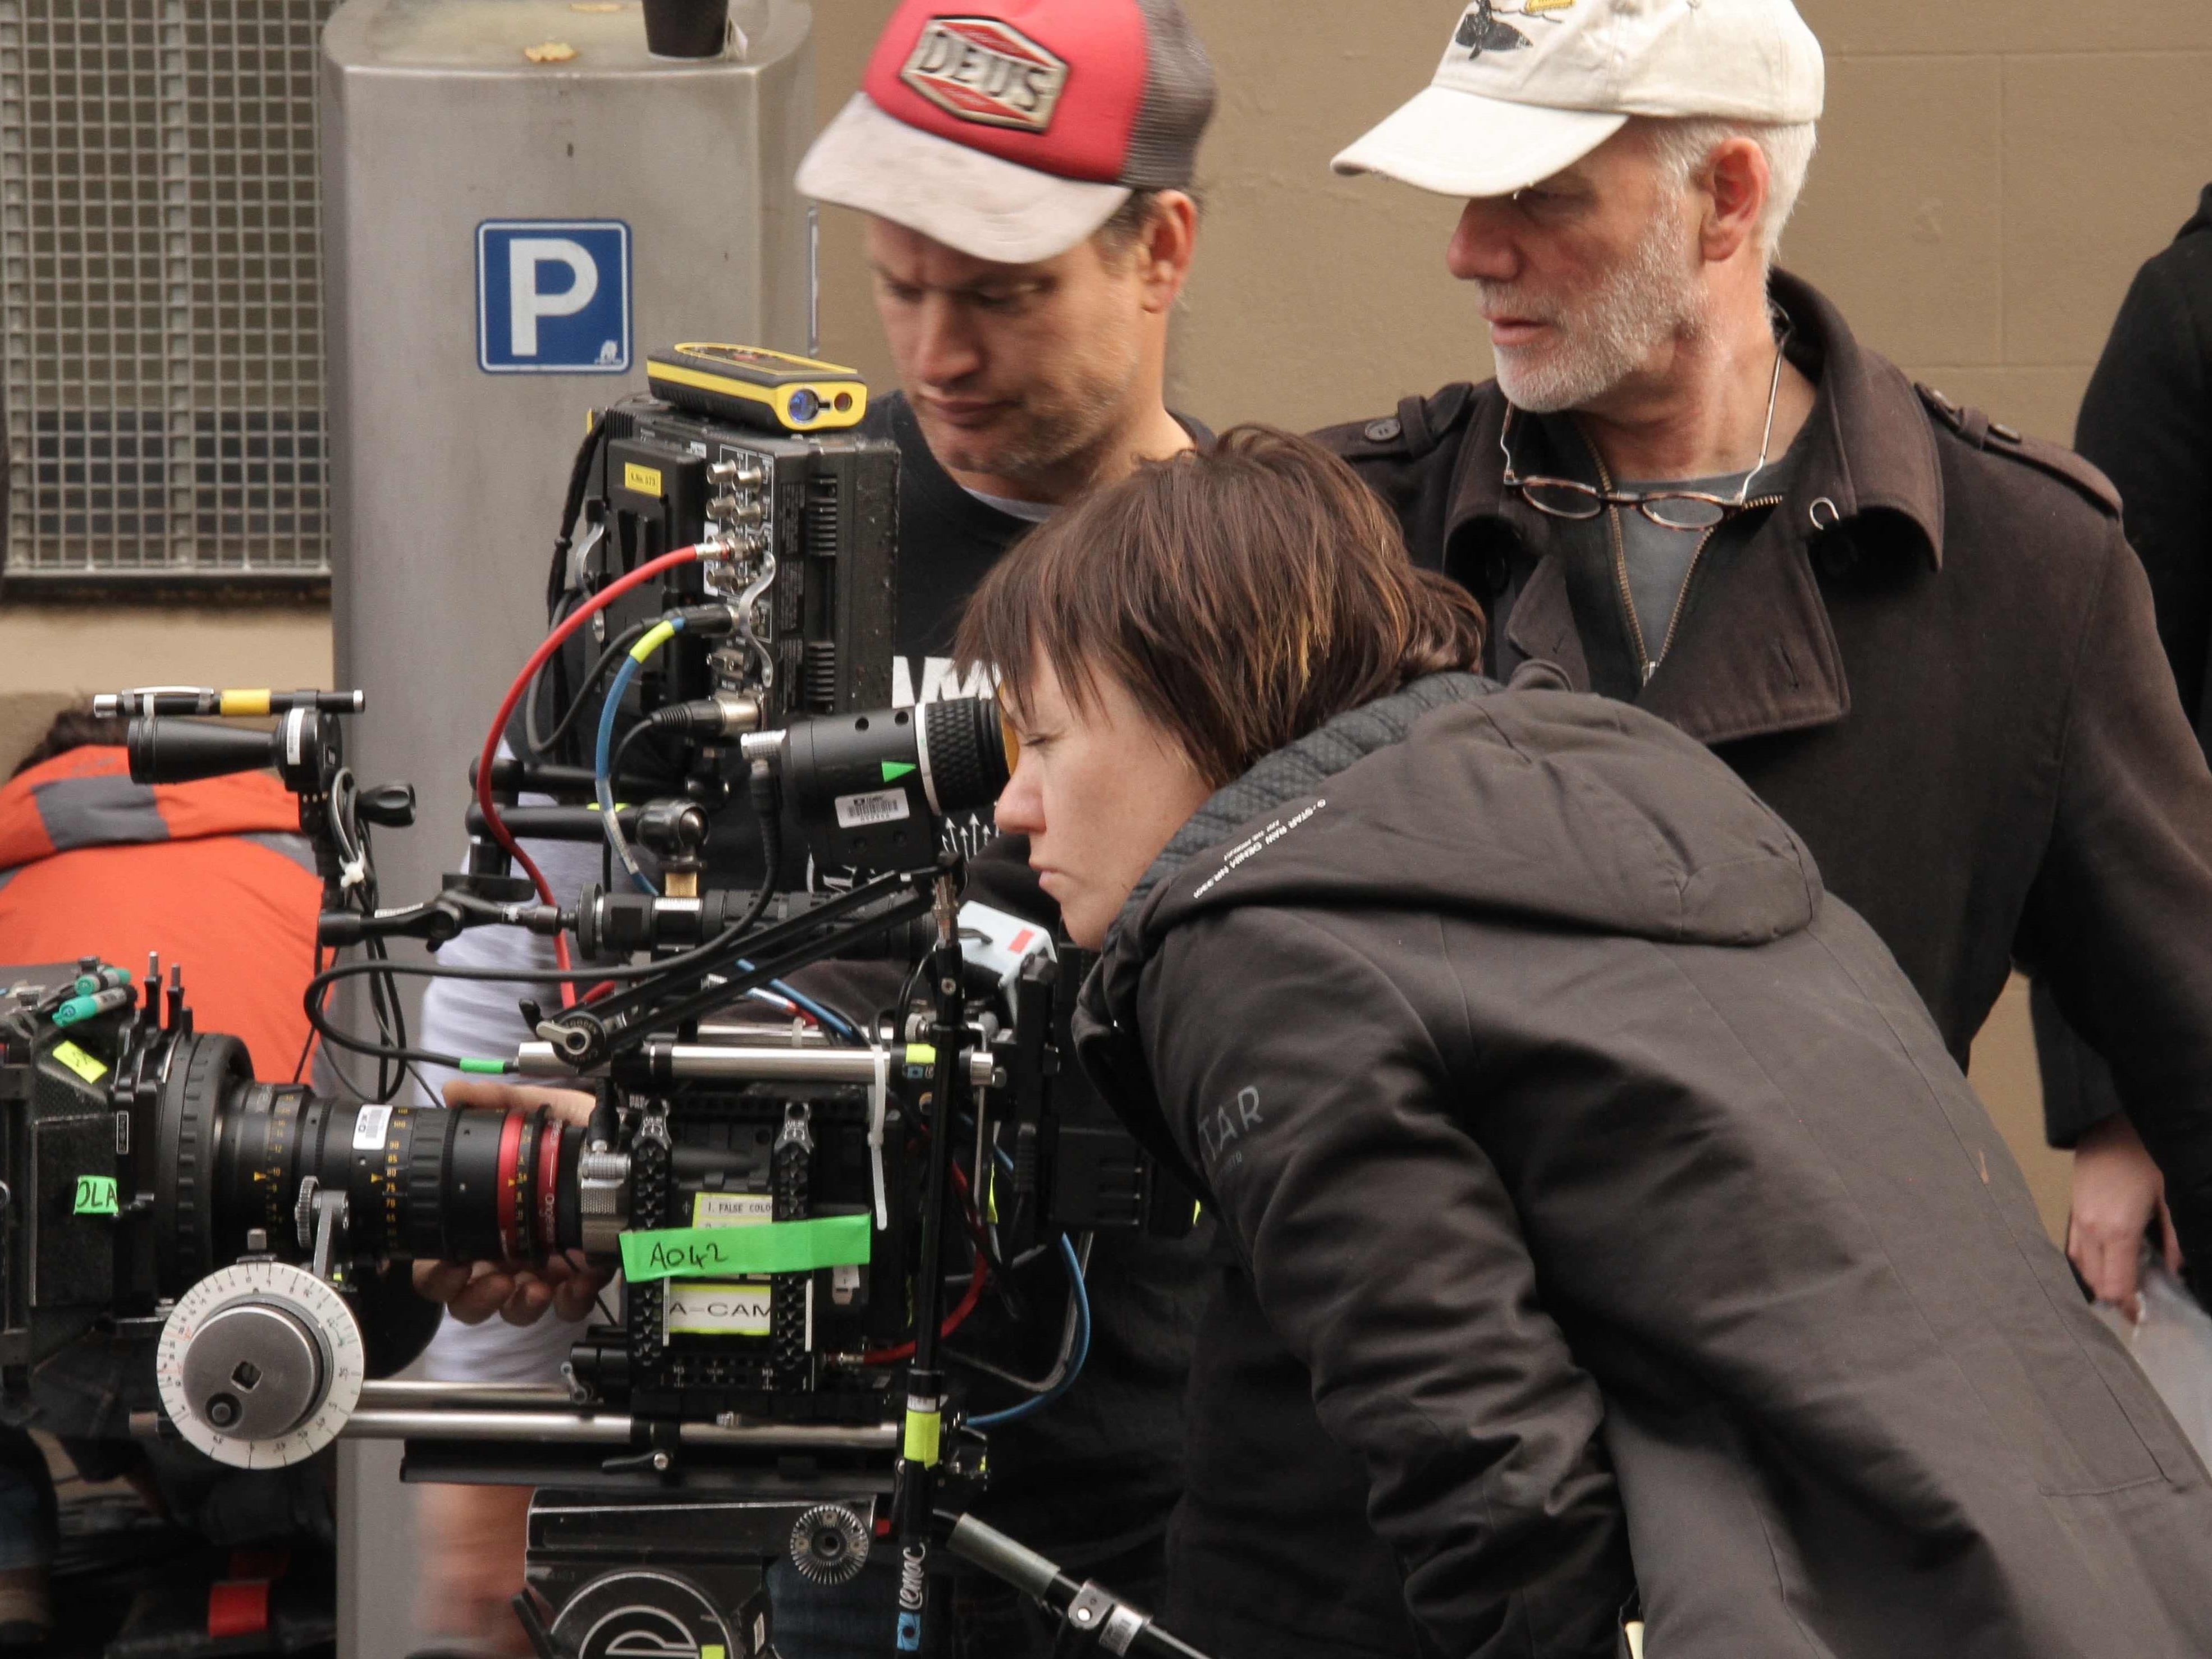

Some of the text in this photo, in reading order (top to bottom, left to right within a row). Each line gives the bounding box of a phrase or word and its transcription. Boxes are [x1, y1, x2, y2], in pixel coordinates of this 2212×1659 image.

[918, 31, 1049, 112] DEUS
[509, 238, 598, 356] P
[719, 1203, 743, 1213] FALSE
[649, 1241, 729, 1271] A042
[670, 1300, 771, 1318] A-CAM
